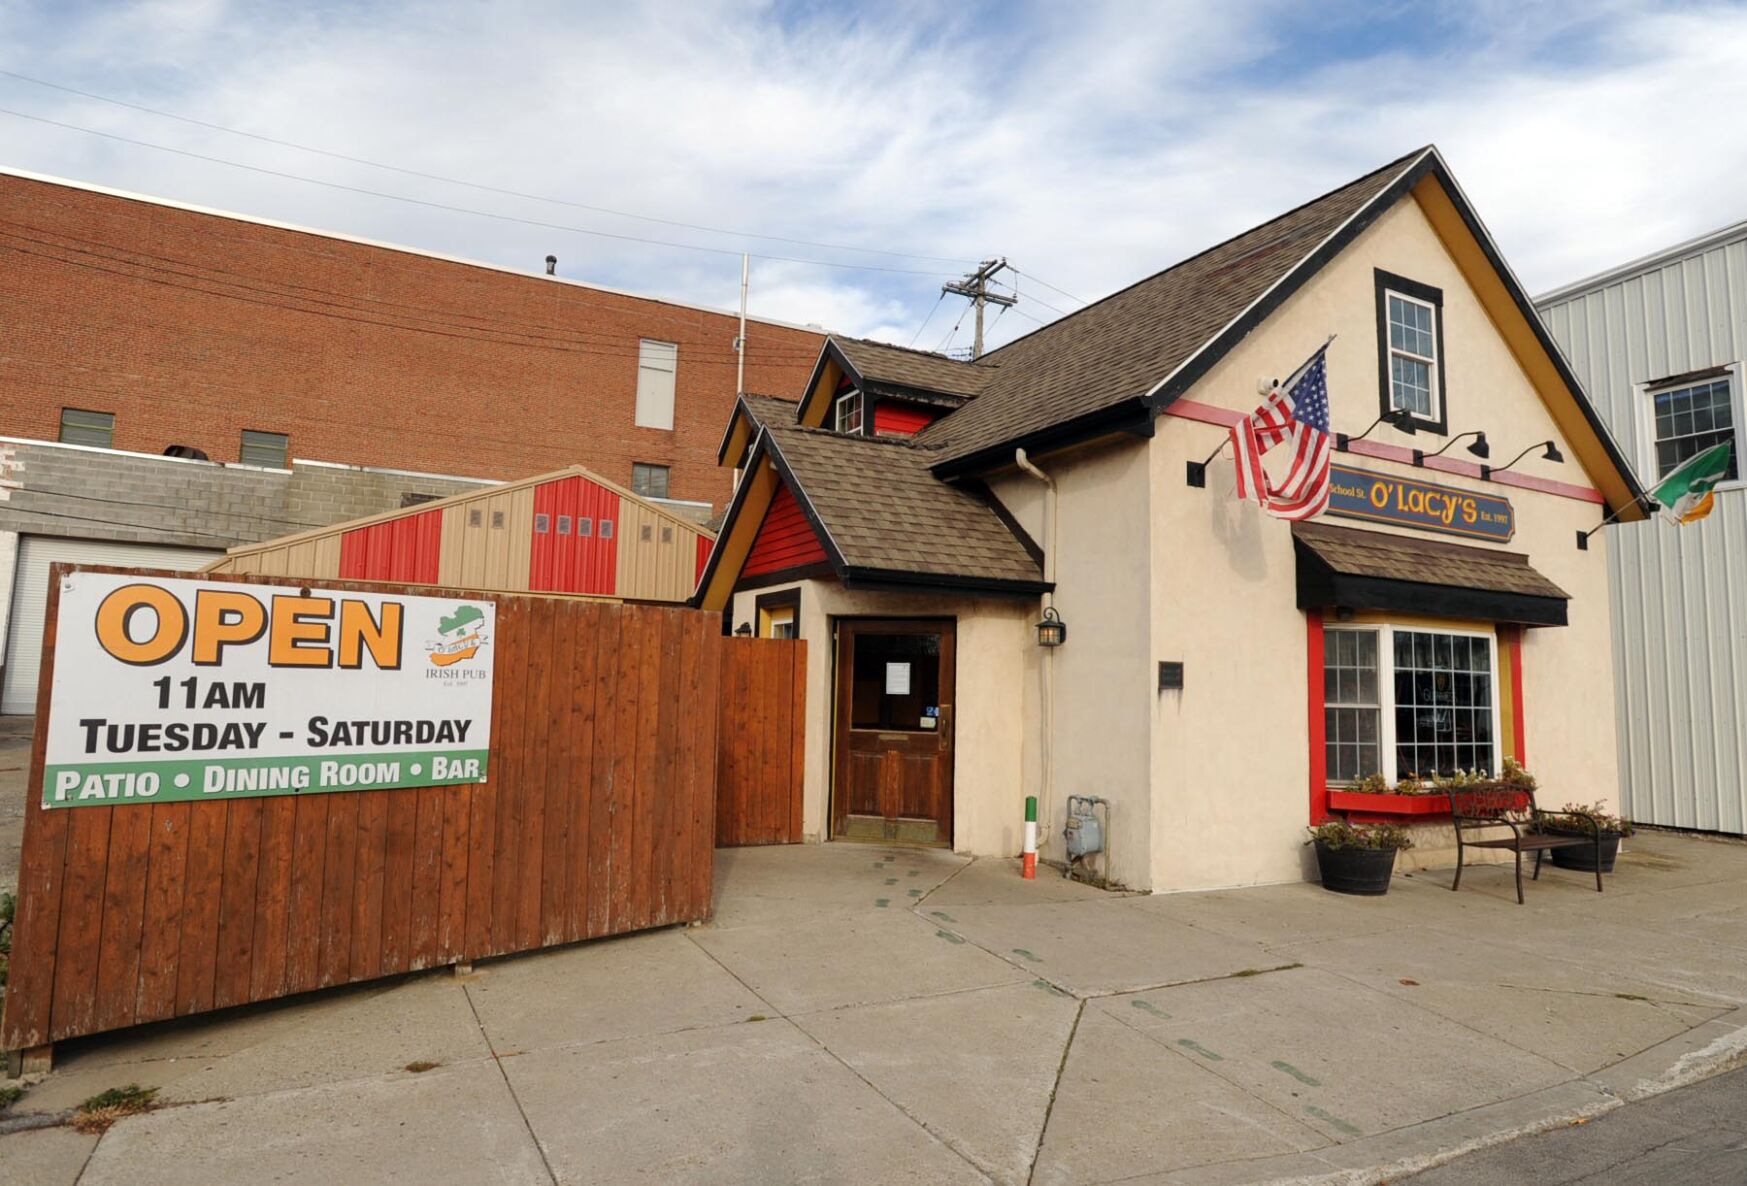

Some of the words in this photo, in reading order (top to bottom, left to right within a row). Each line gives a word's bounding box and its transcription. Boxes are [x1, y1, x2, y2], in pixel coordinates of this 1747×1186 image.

[94, 583, 403, 670] OPEN
[153, 676, 266, 709] 11AM
[425, 668, 459, 679] IRISH
[463, 669, 486, 680] PUB
[80, 719, 267, 754] TUESDAY
[307, 716, 472, 748] SATURDAY
[55, 771, 160, 801] PATIO
[203, 765, 310, 793] DINING
[320, 761, 400, 787] ROOM
[432, 756, 480, 780] BAR
